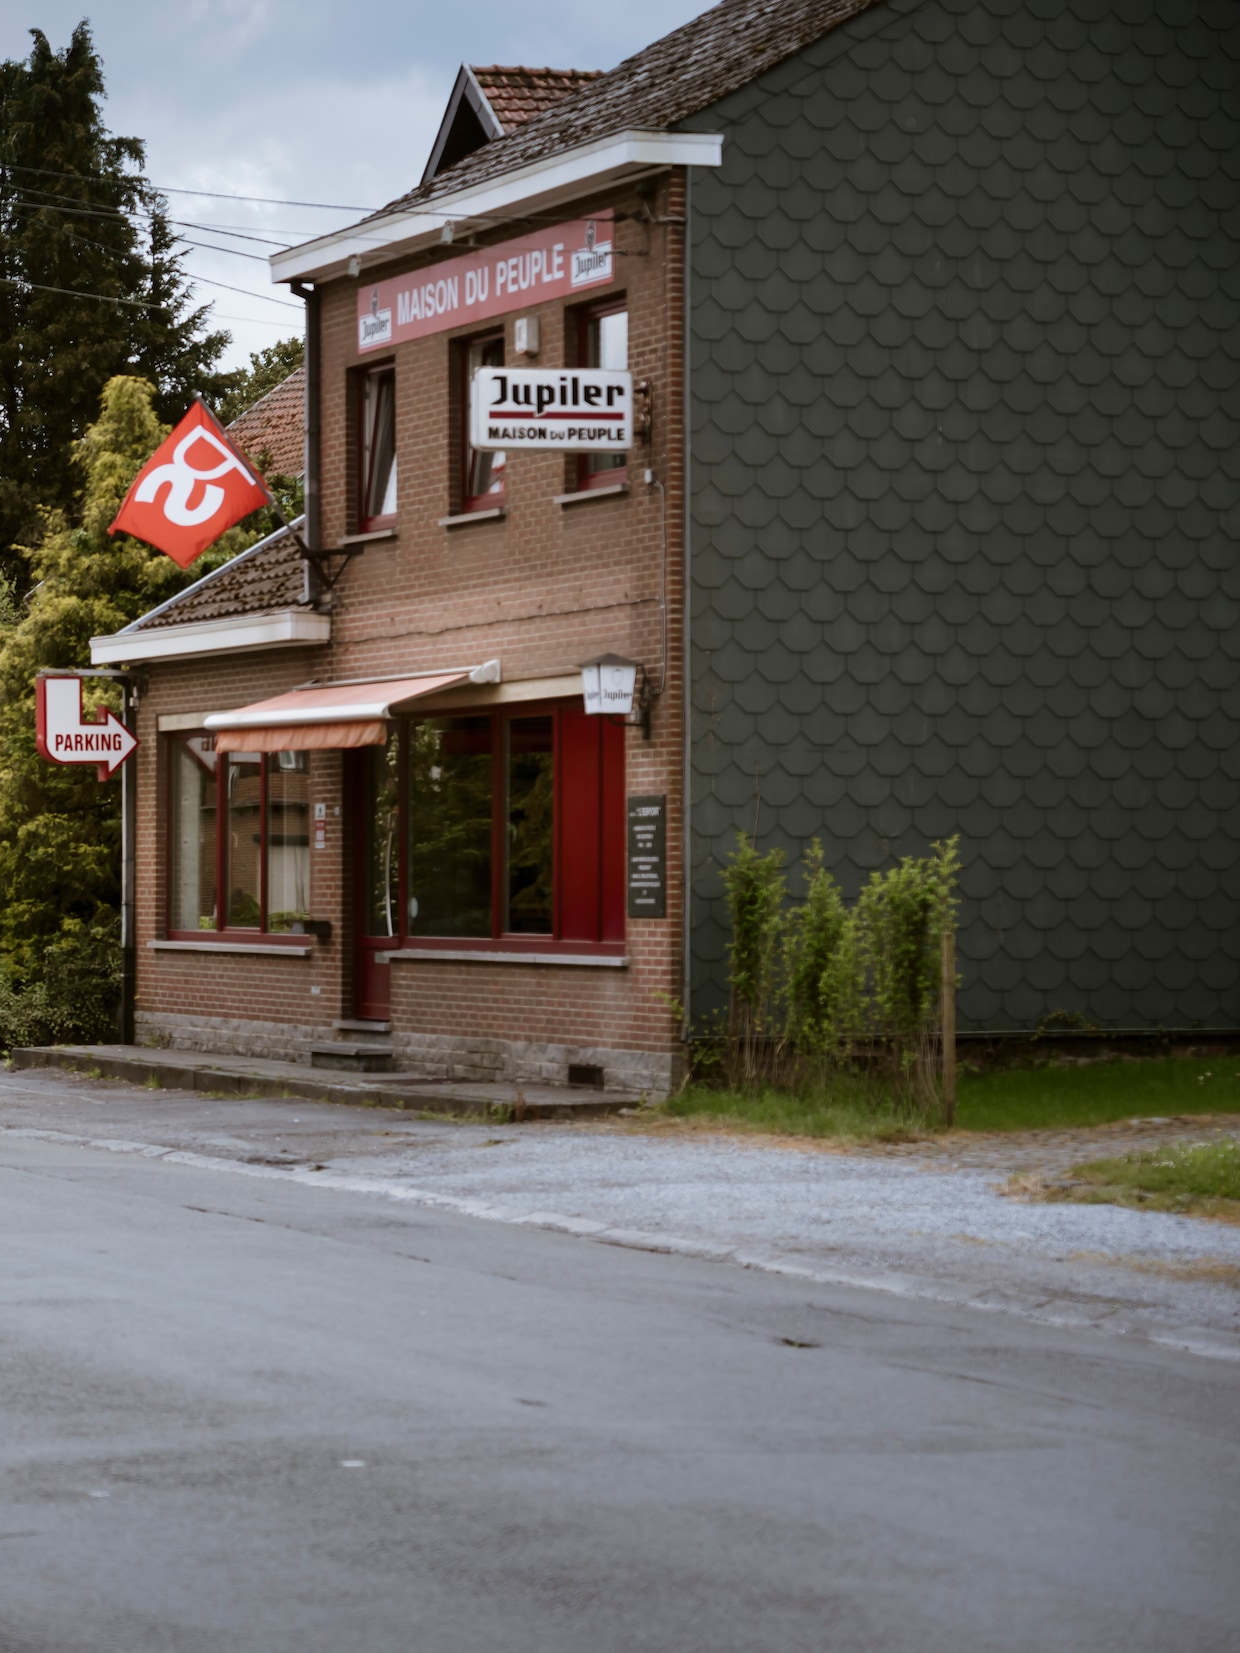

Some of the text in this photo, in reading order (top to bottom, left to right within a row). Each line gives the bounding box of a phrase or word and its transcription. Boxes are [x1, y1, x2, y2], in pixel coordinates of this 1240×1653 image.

[574, 250, 608, 279] Jupiler
[397, 243, 564, 326] MAISON DU PEUPLE
[362, 318, 390, 342] Jupiler
[490, 375, 625, 415] Jupiler
[488, 426, 625, 441] MAISON DU PEUPLE
[55, 733, 122, 751] PARKING
